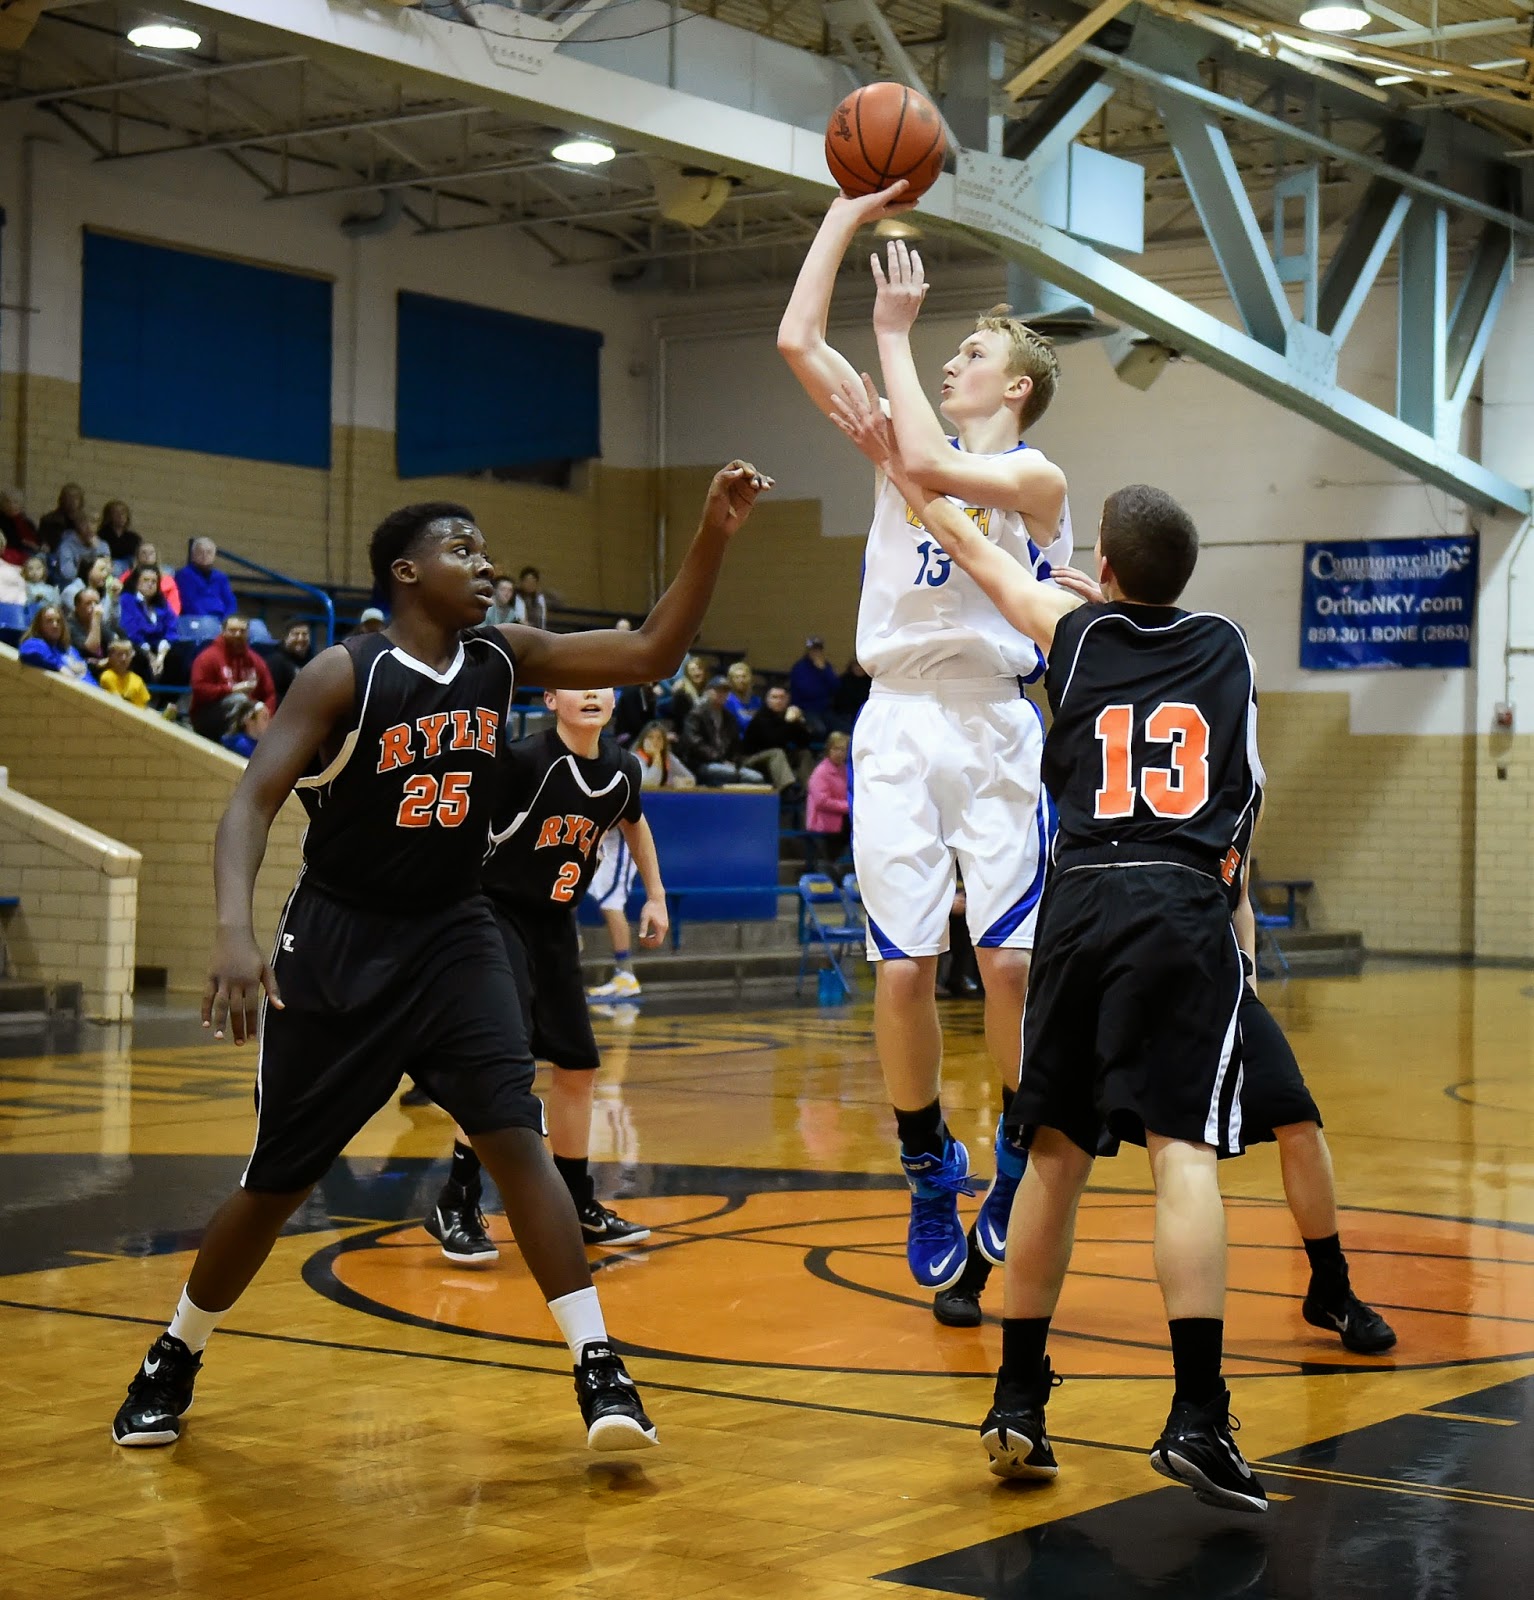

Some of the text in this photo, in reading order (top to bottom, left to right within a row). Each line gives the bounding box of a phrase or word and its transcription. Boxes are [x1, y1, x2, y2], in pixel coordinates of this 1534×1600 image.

[913, 540, 953, 587] 13
[1311, 549, 1452, 580] Commonwealth
[1316, 594, 1463, 615] OrthoNKY.com
[1308, 624, 1470, 644] 859.301.BONE (2663)
[376, 706, 499, 774] RYLE
[1093, 701, 1210, 819] 13
[396, 771, 473, 828] 25
[534, 814, 599, 861] RYL
[550, 861, 581, 903] 2
